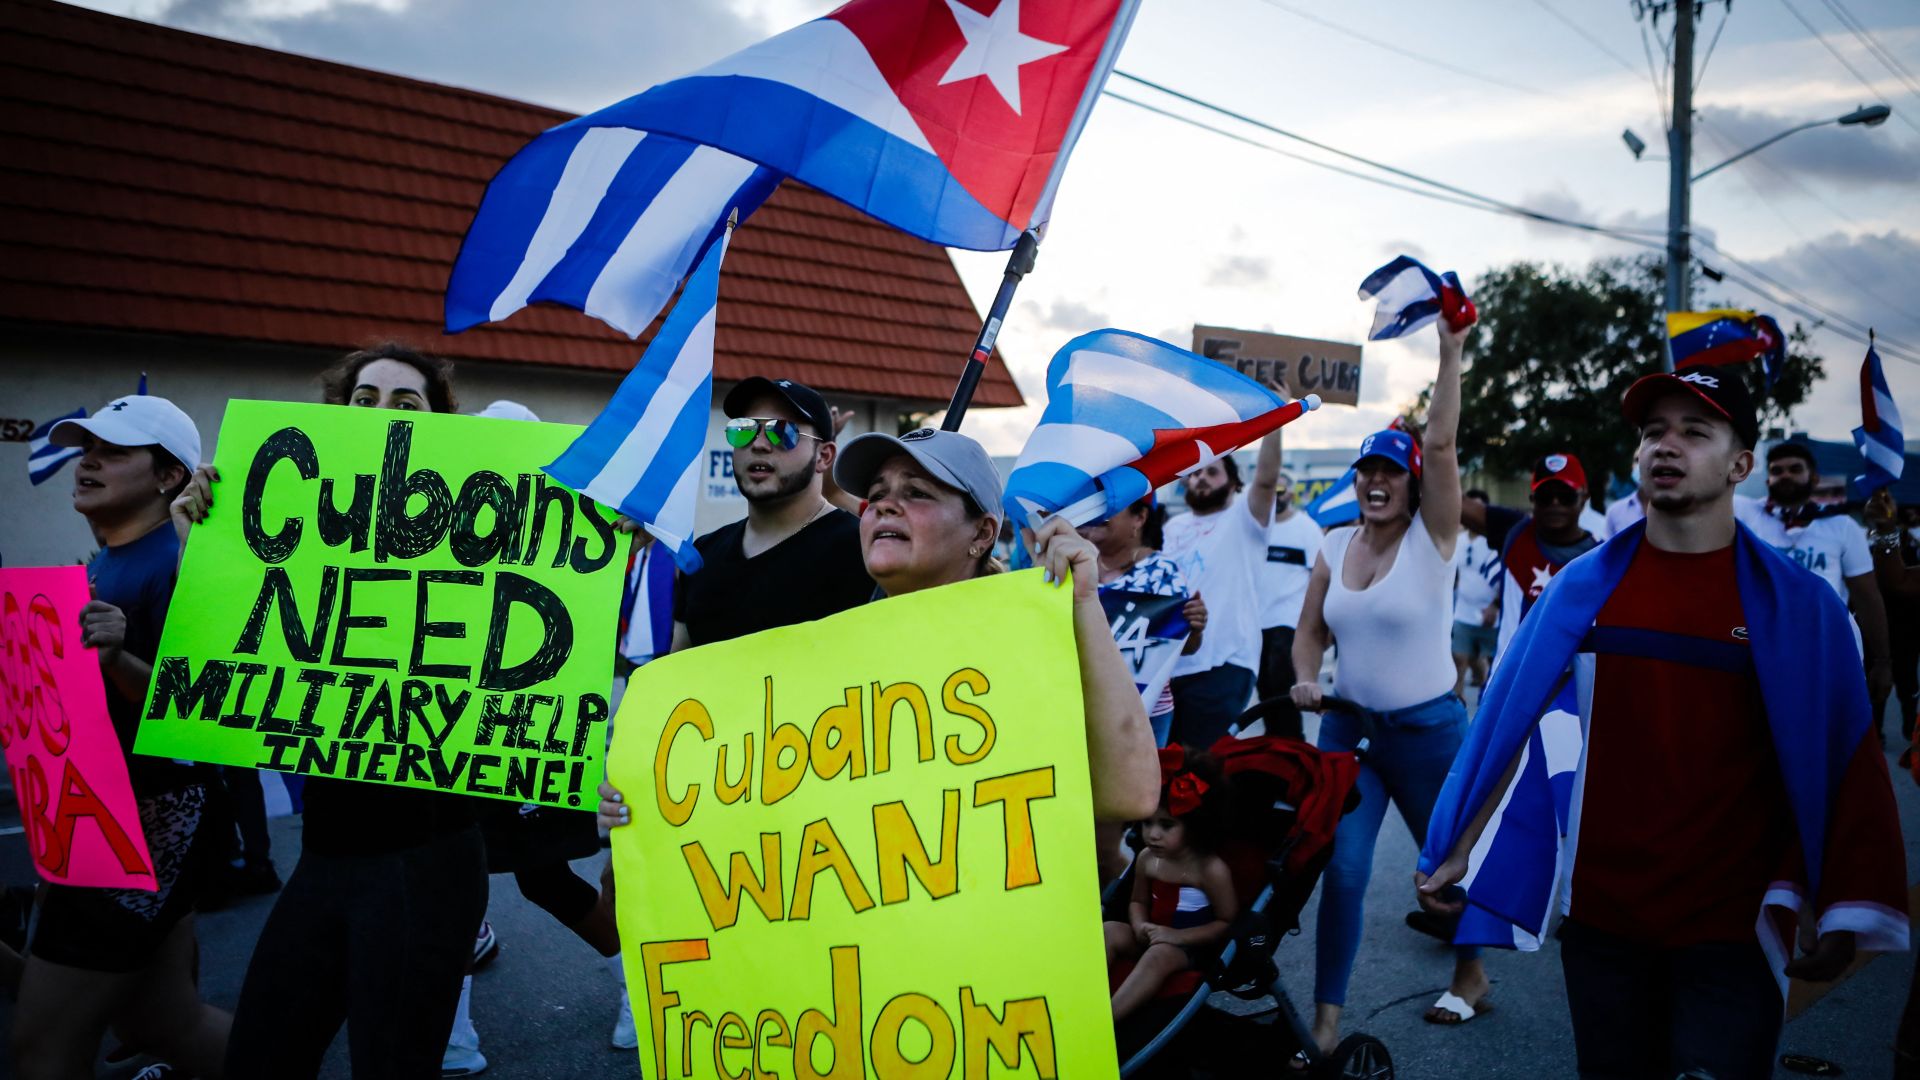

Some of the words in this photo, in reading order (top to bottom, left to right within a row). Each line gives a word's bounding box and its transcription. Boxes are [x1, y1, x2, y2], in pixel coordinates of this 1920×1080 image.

[242, 420, 617, 574] Cubans
[0, 591, 70, 757] OS
[146, 656, 472, 750] MILITARY
[232, 565, 574, 692] NEED
[256, 733, 585, 807] INTERVENE!
[654, 667, 997, 827] Cubans
[681, 765, 1056, 931] WANT
